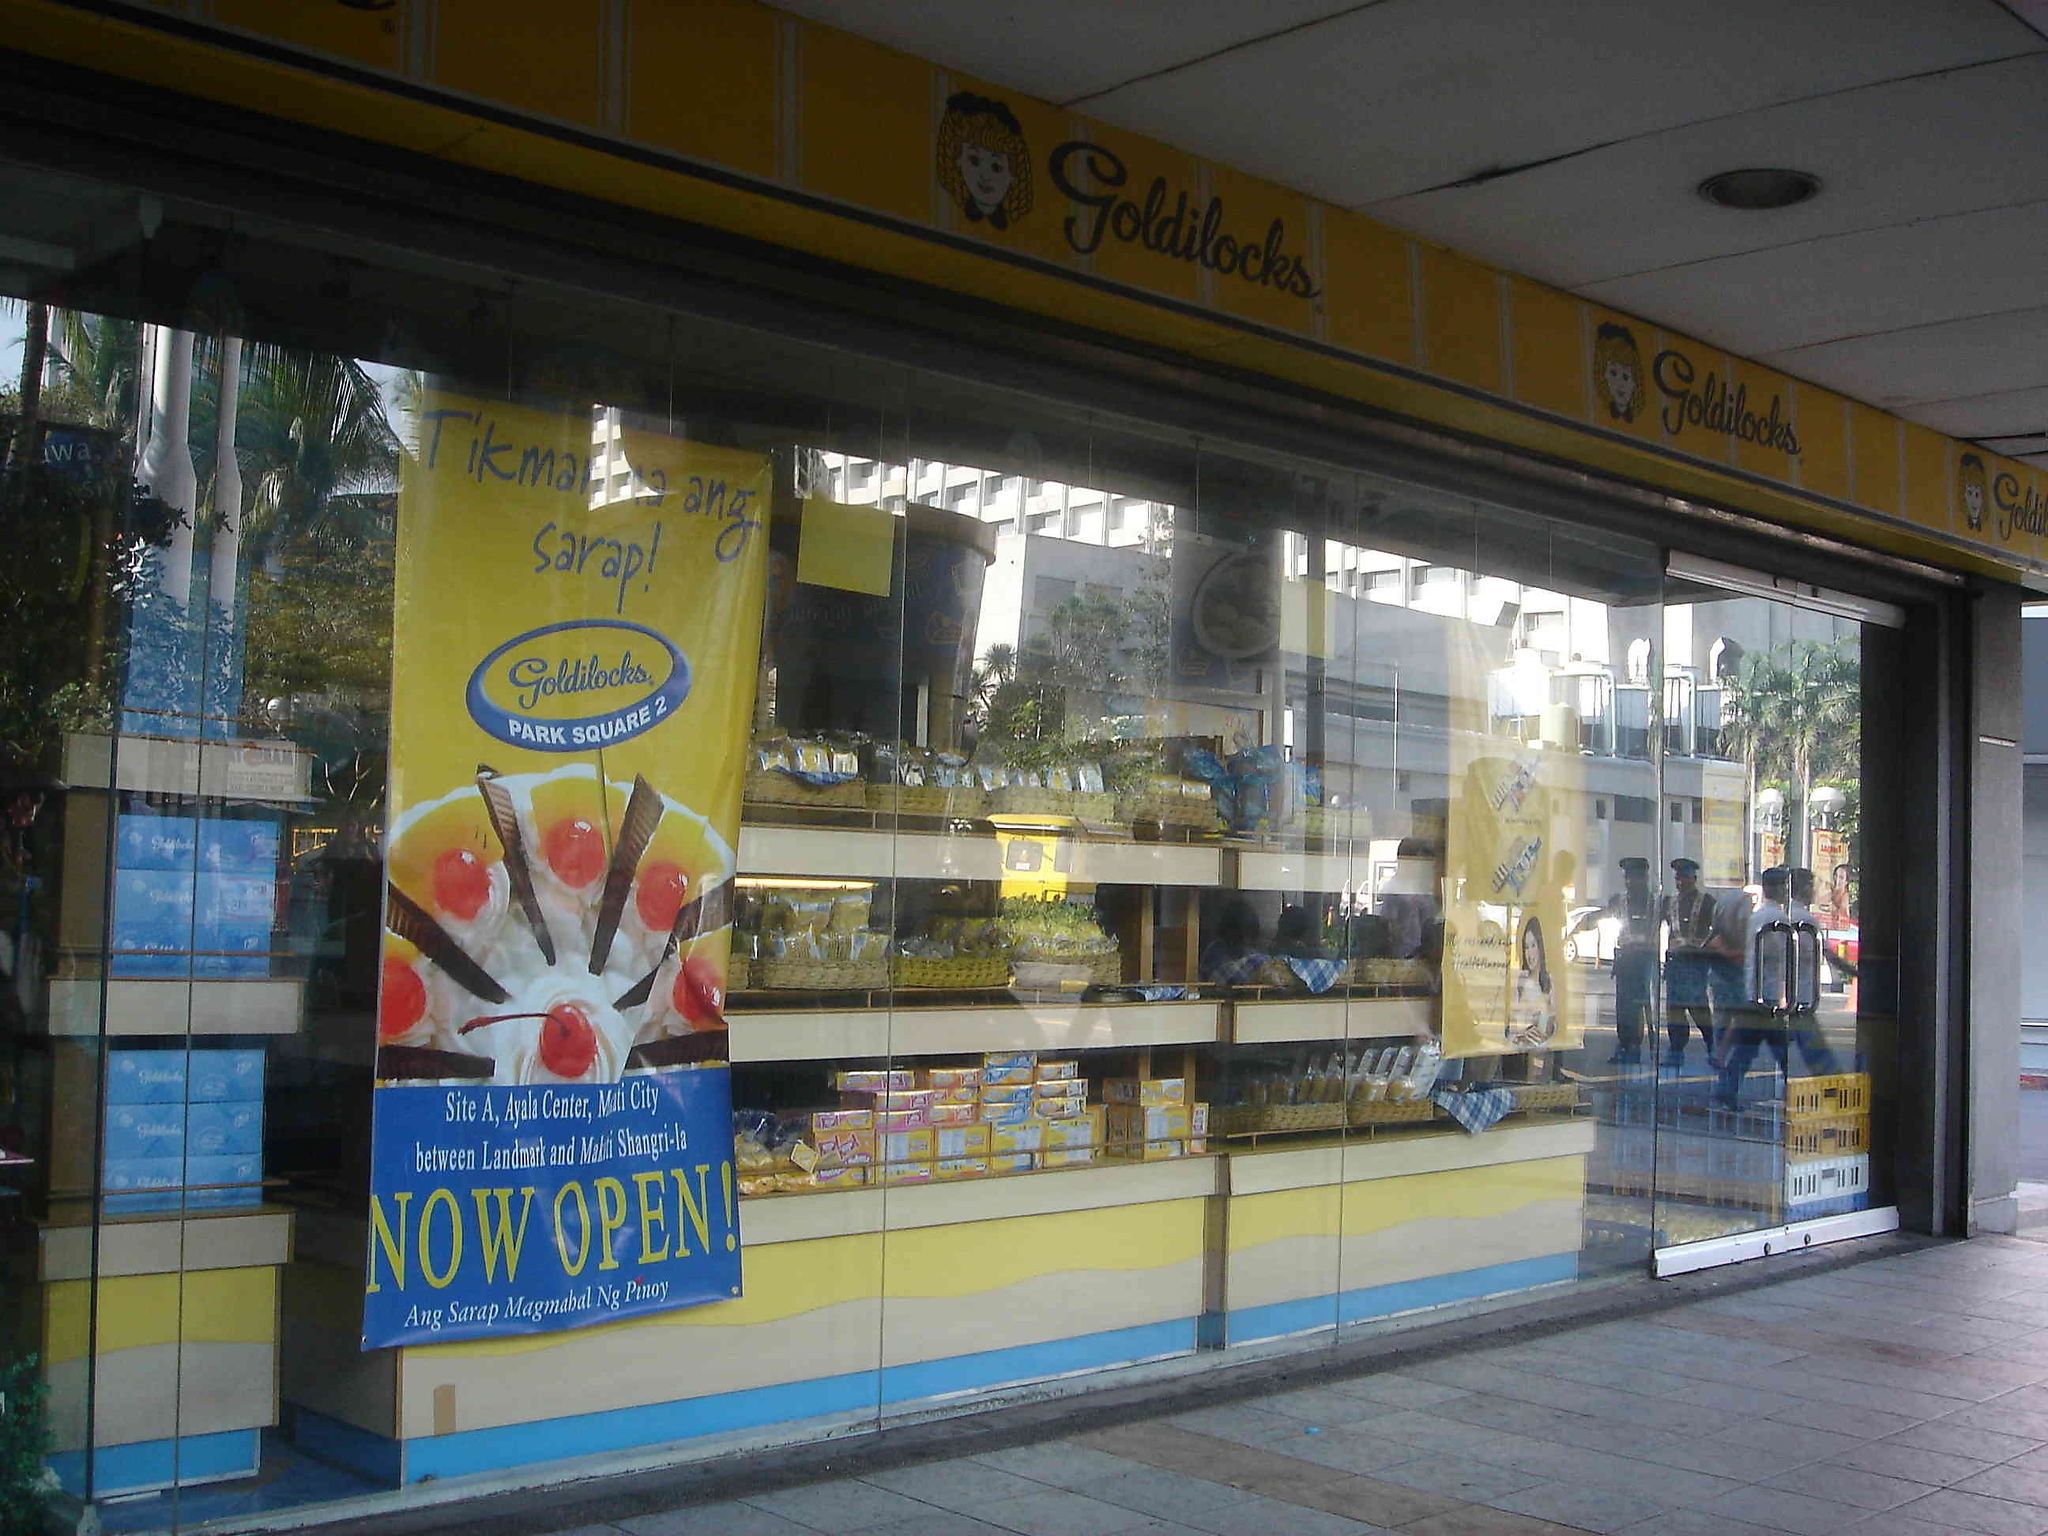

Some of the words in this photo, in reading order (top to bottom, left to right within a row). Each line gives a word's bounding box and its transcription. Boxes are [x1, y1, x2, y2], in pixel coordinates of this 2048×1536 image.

[1048, 140, 1321, 299] Goldilocks
[1653, 350, 1802, 455] Goldilocks
[683, 473, 761, 563] ang
[508, 651, 649, 710] Goldilocks
[508, 719, 567, 745] PARK
[572, 705, 651, 744] SQUARE
[655, 695, 667, 716] 2
[446, 1090, 477, 1122] Site
[481, 1091, 500, 1128] A,
[504, 1089, 538, 1128] Ayala
[542, 1089, 592, 1124] Center,
[630, 1079, 659, 1115] City
[416, 1140, 475, 1173] between
[482, 1137, 545, 1170] Landmark
[551, 1135, 575, 1165] and
[617, 1121, 688, 1162] Shangri-la
[366, 1186, 535, 1294] NOW
[404, 1304, 443, 1331] Ang
[448, 1301, 500, 1327] Sarap
[504, 1286, 592, 1322] Magmahal
[597, 1284, 620, 1309] Ng
[625, 1279, 670, 1302] Pinoy
